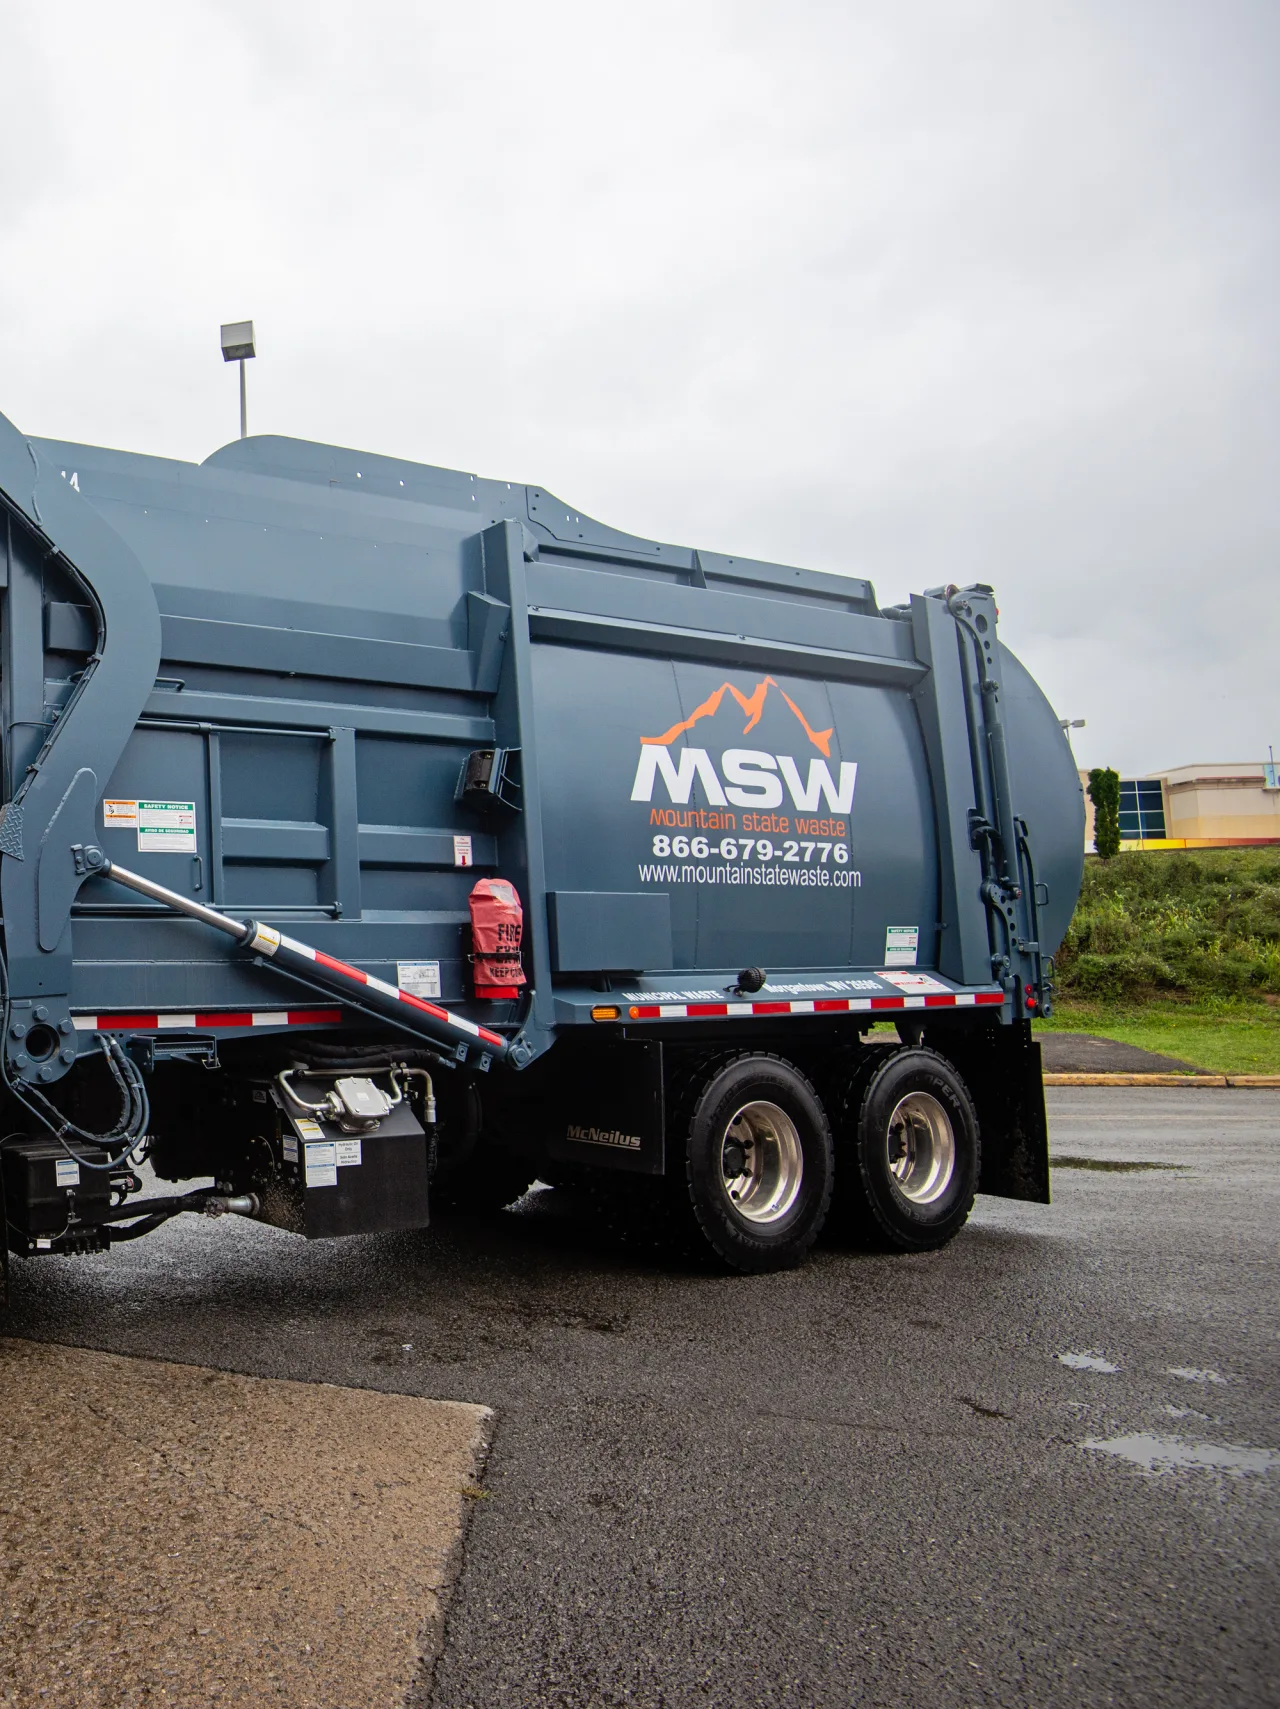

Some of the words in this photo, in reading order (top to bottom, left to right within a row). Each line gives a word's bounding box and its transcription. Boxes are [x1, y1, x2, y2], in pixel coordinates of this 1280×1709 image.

[630, 743, 858, 815] MSW
[742, 812, 790, 832] state
[794, 816, 846, 837] waste
[651, 834, 849, 864] 866-679-2776
[638, 861, 862, 888] www.mountainstatewaste.com
[497, 923, 522, 942] FIRE
[489, 967, 509, 978] KEEP
[621, 991, 688, 1002] MUNICIPAL
[680, 990, 725, 1000] WASTE
[566, 1124, 641, 1147] McNeilus
